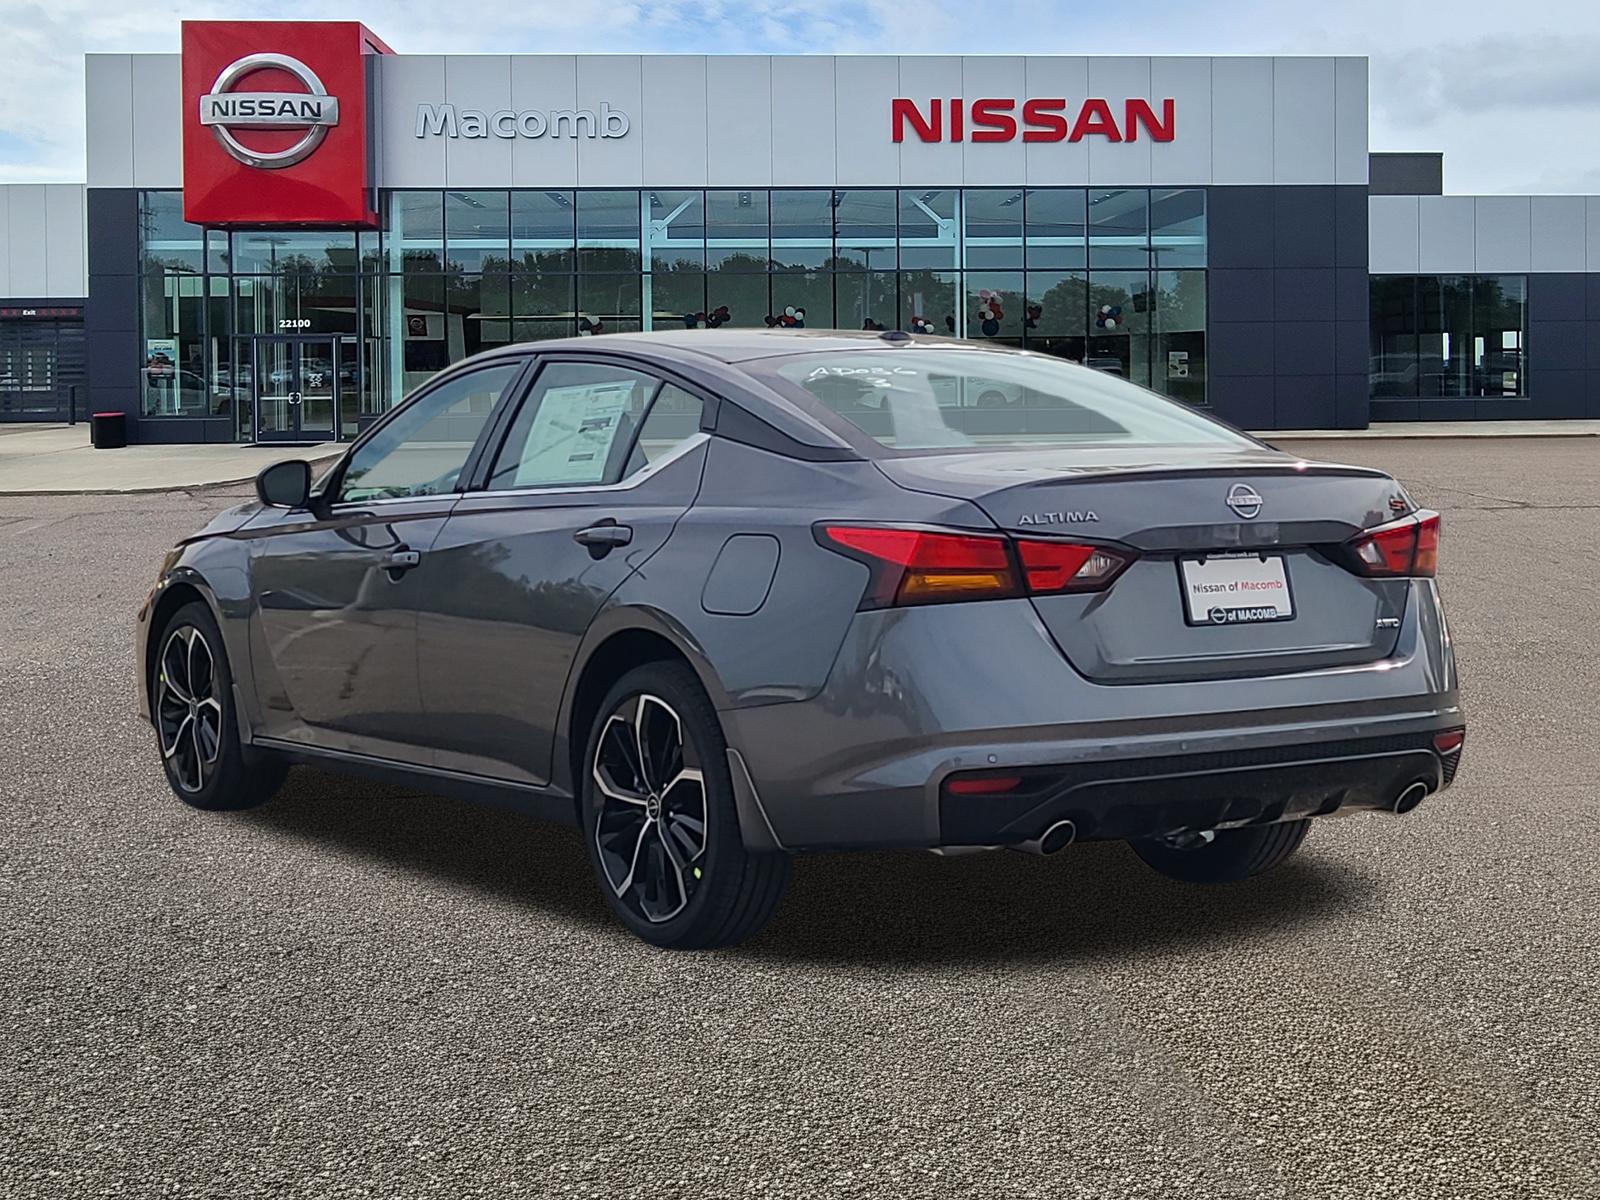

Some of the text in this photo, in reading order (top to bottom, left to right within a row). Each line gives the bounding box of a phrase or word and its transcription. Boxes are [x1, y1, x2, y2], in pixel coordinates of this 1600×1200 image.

[211, 100, 322, 118] NISSAN
[415, 102, 630, 139] Macomb
[892, 98, 1175, 143] NISSAN
[279, 319, 311, 328] 22100
[1018, 511, 1099, 526] ALTIMA
[1193, 580, 1283, 594] Nissan of Macomb
[1227, 613, 1237, 621] of
[1238, 609, 1278, 620] MACOMB
